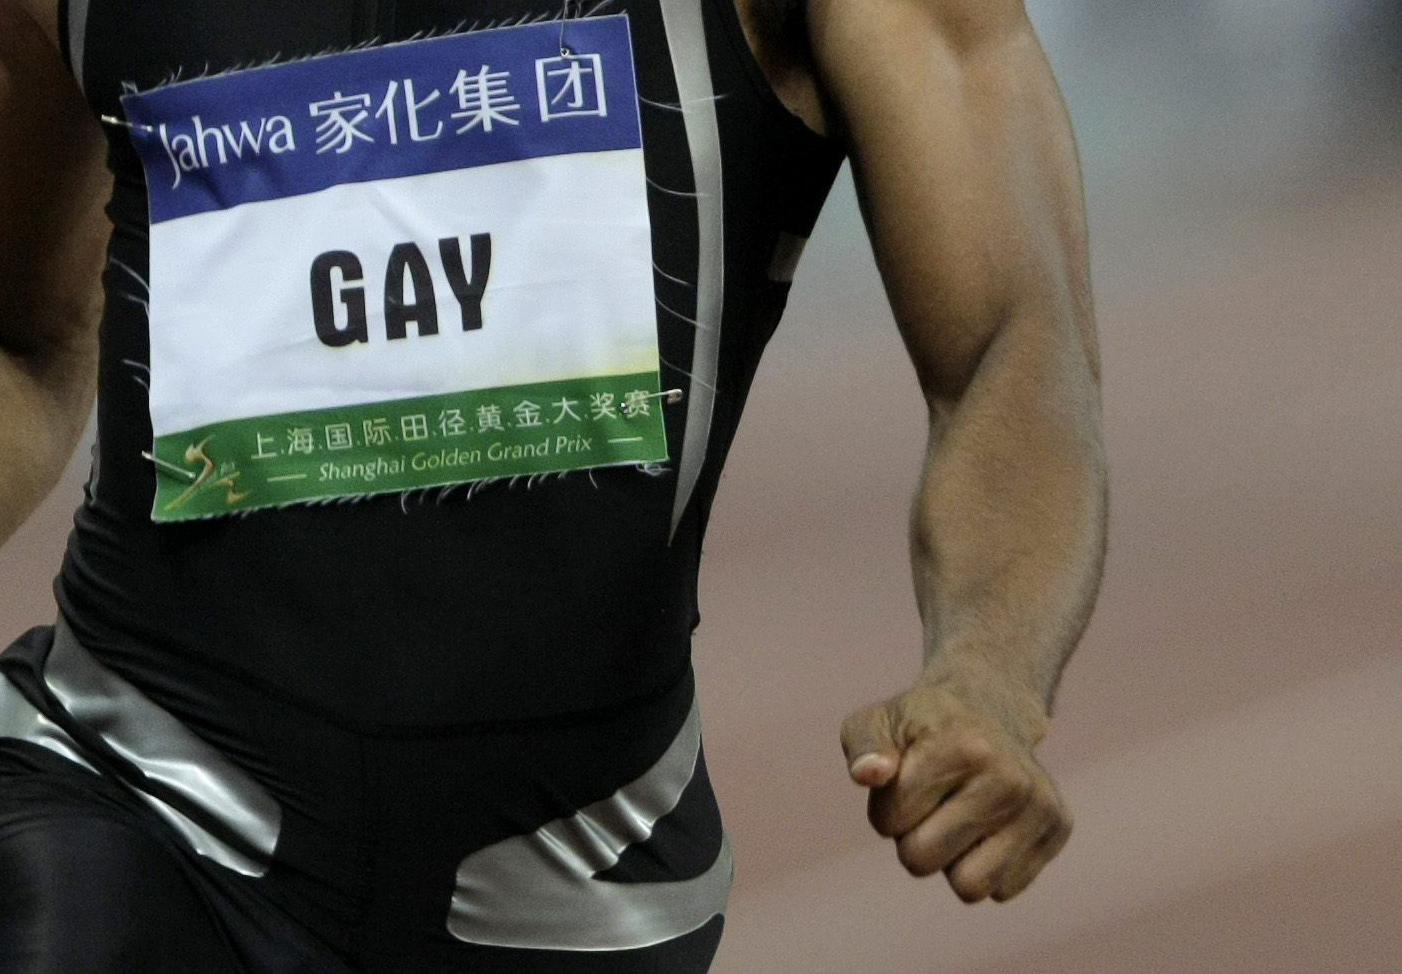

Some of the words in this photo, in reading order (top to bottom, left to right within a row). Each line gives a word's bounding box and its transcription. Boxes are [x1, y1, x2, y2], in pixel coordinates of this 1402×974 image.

[309, 52, 608, 155] 家化集团
[159, 115, 296, 190] Jahwa
[309, 232, 492, 348] GAY
[319, 455, 406, 482] Shanghai
[411, 447, 482, 472] Golden
[487, 438, 549, 461] Grand
[555, 433, 593, 454] Prix
